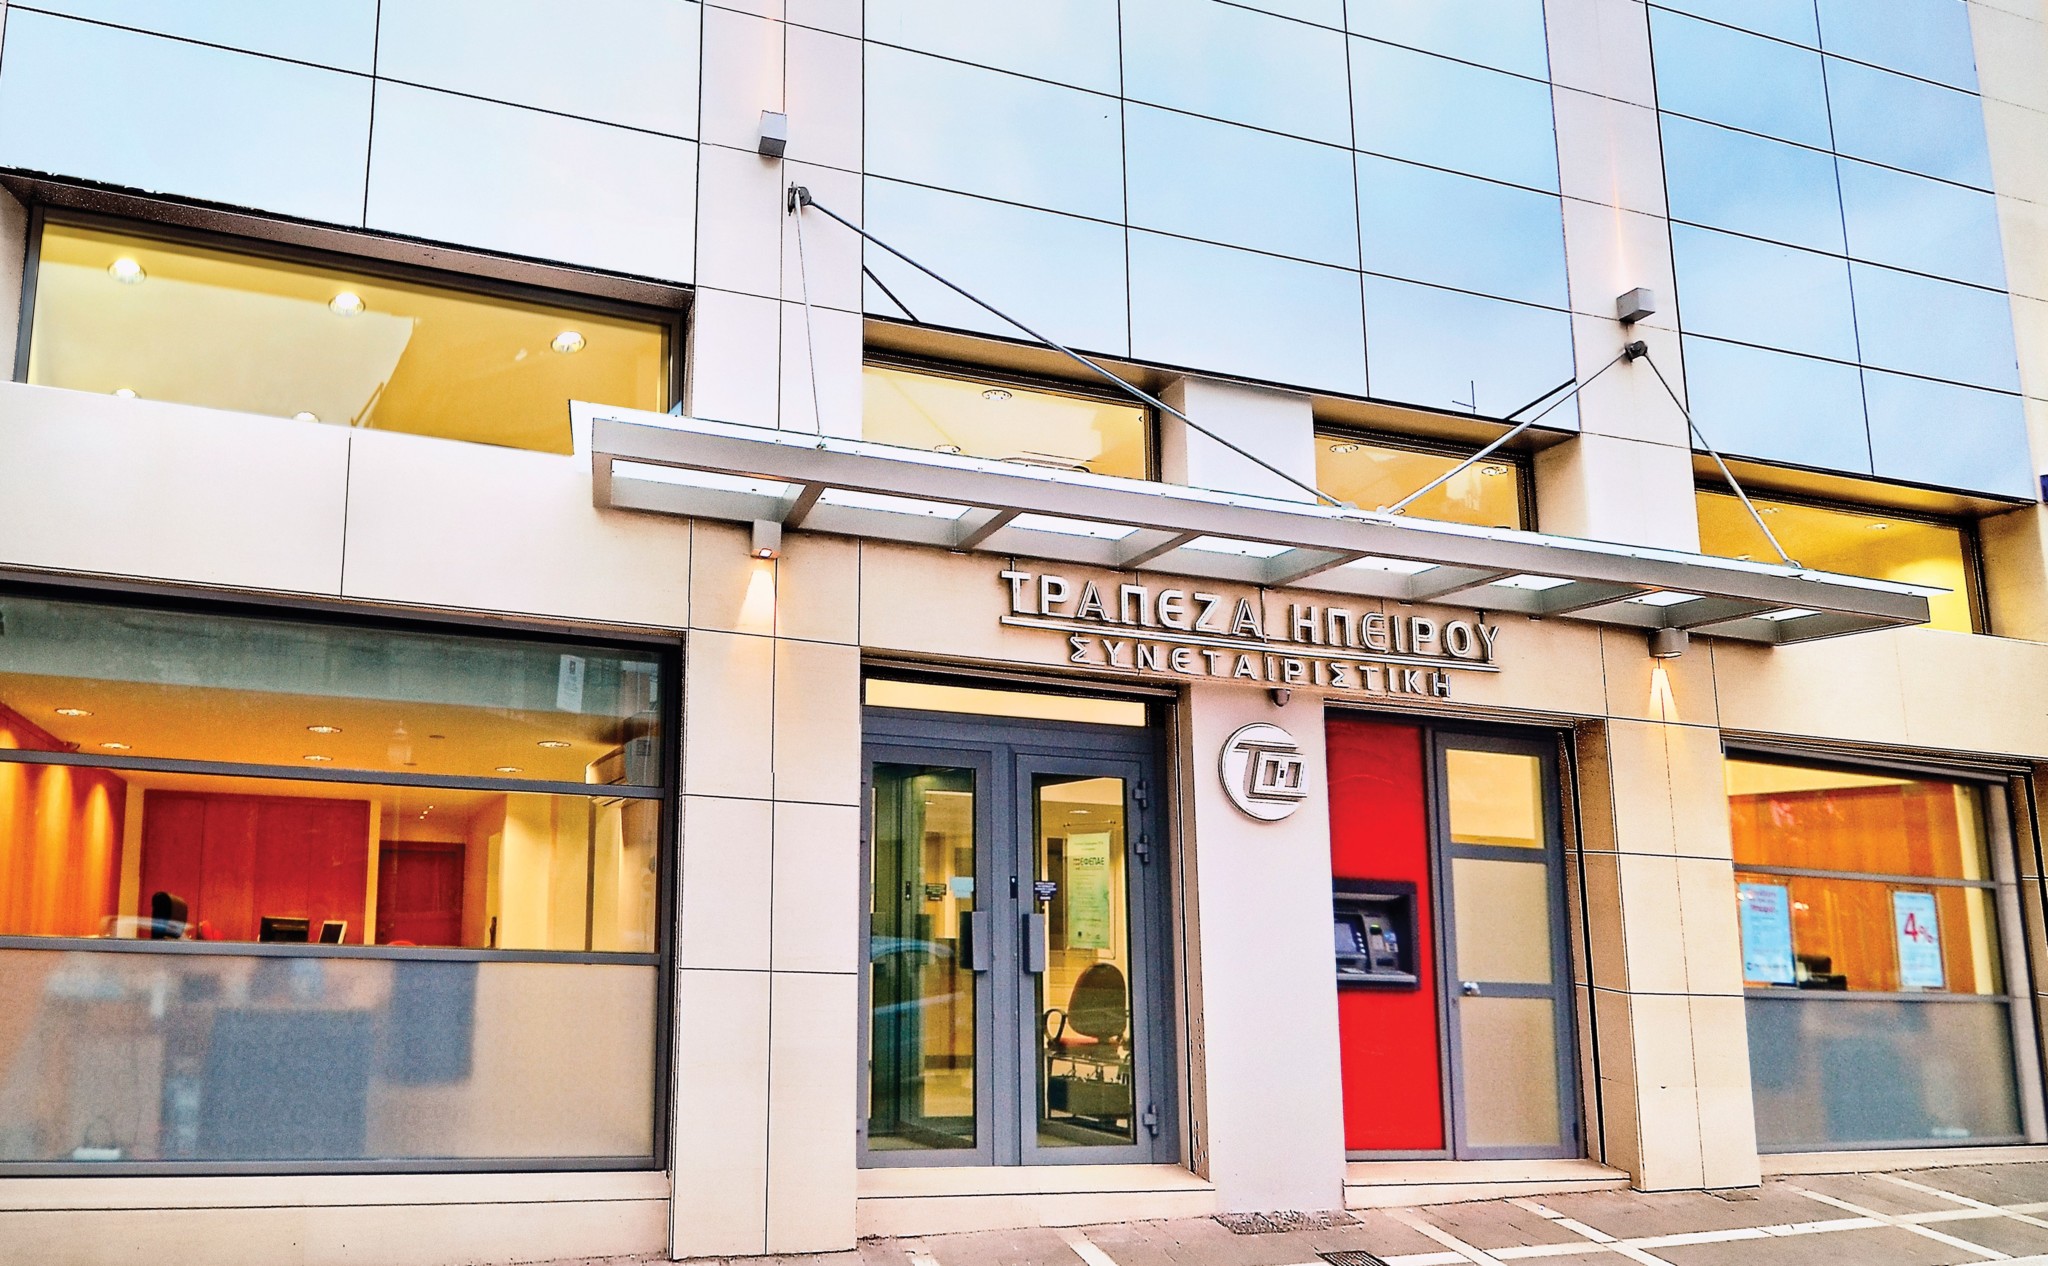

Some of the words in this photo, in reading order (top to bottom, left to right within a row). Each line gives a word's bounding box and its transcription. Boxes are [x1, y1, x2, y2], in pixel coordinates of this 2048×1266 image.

[1001, 570, 1267, 638] ΤΡΑΠΕΖΑ
[1291, 602, 1500, 662] ΗΠΕΙΡΟΥ
[1069, 634, 1452, 698] ΣΥΝΕΤΑΙΡΙΣΤΙΚΗ
